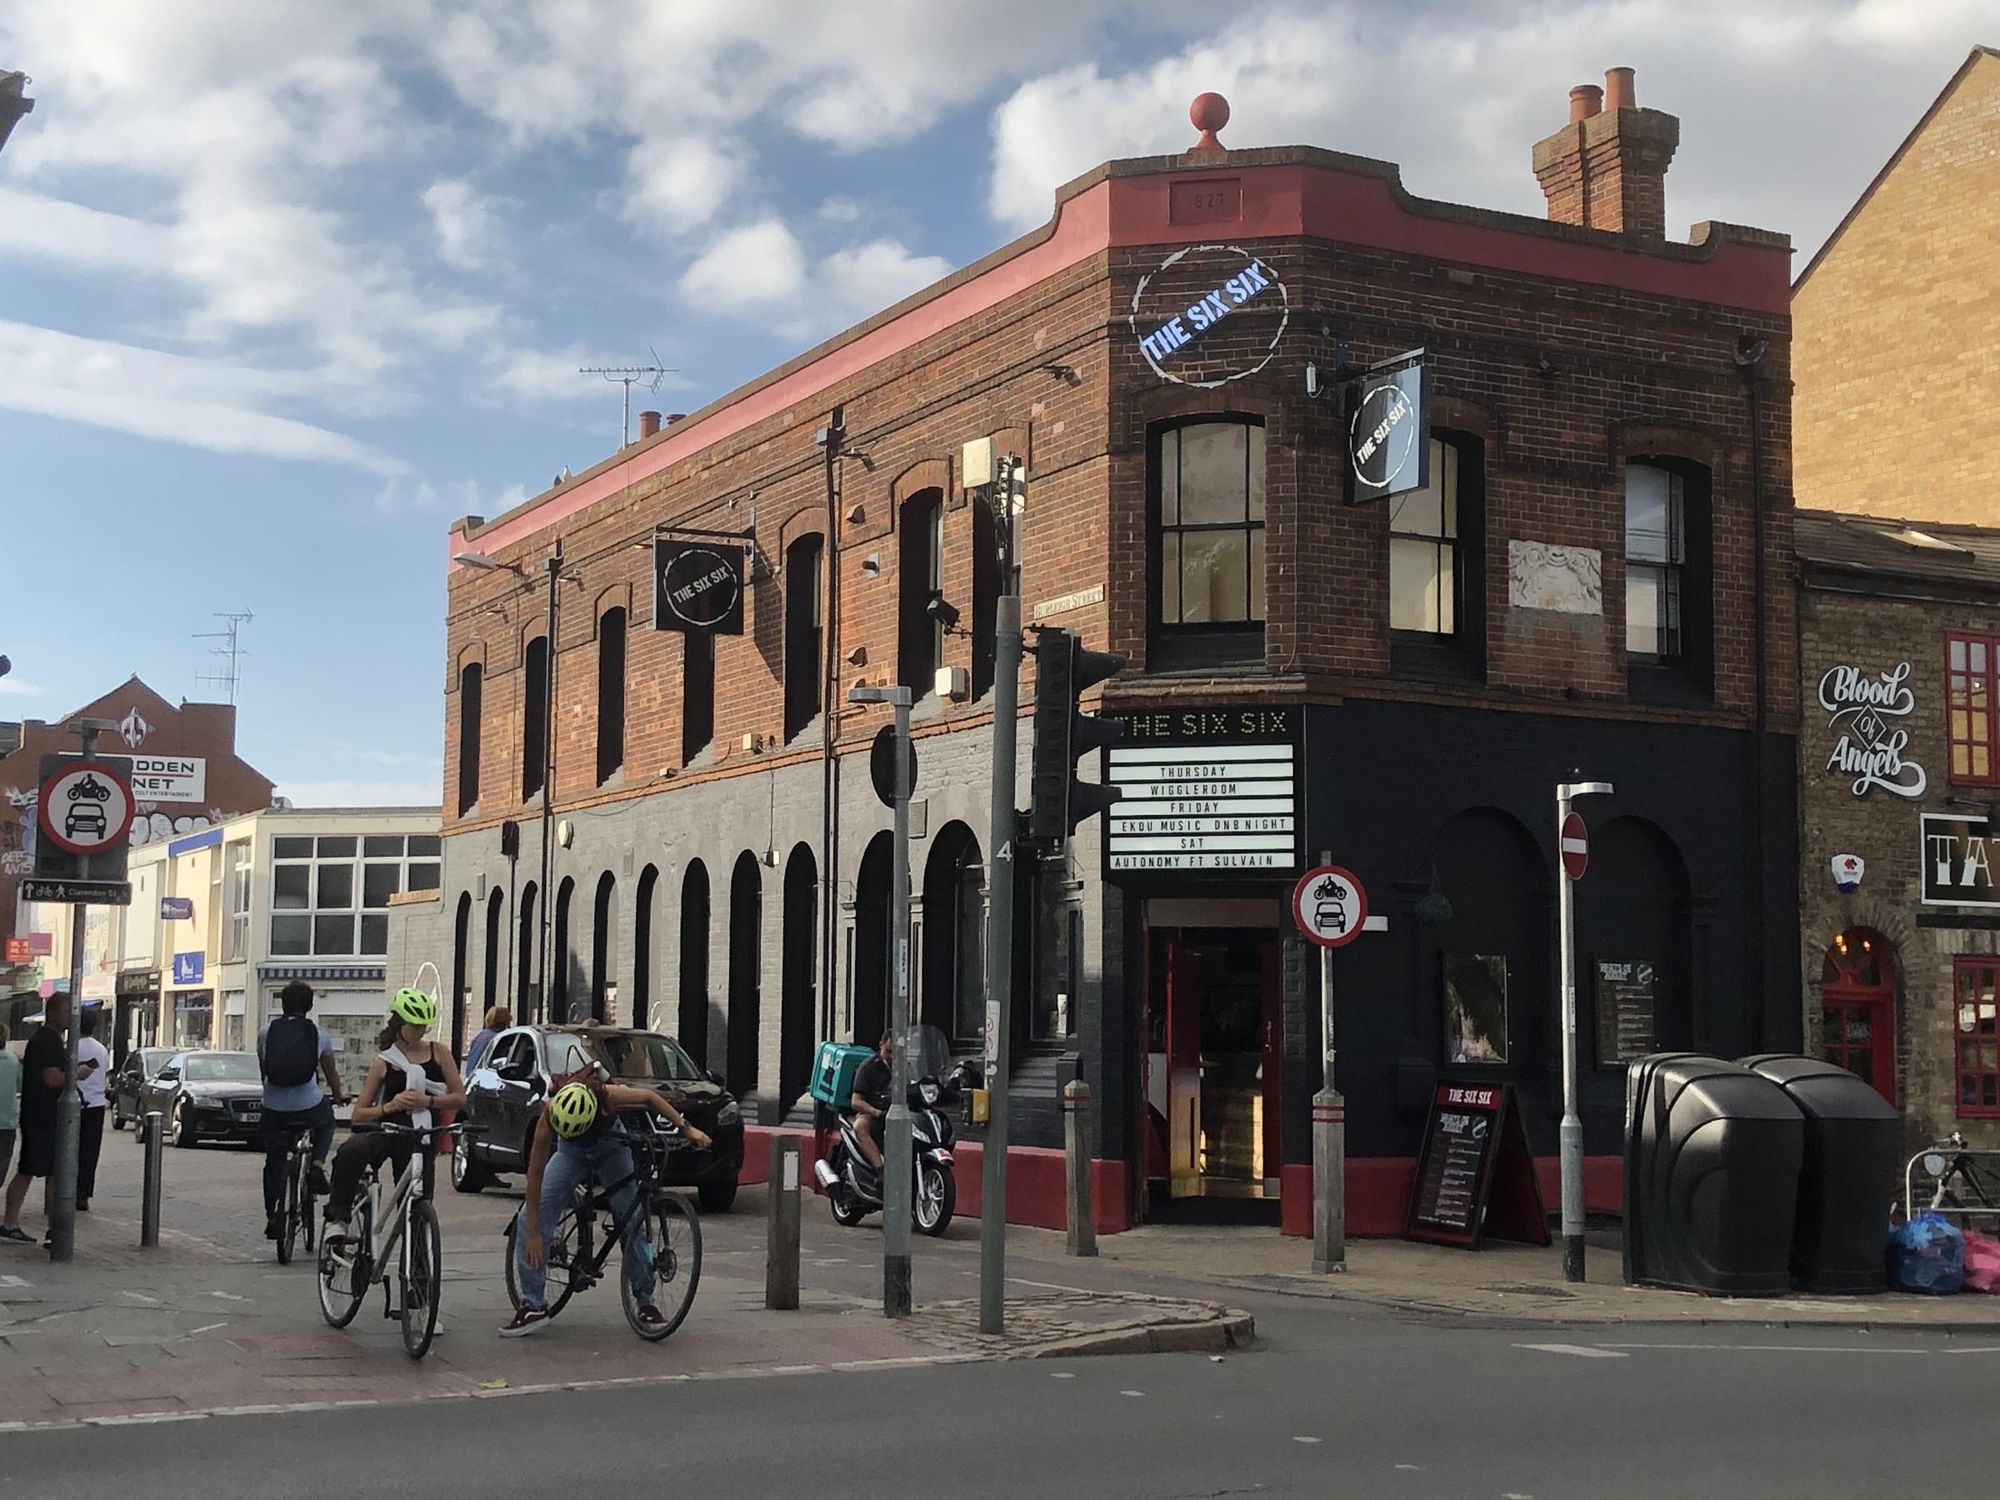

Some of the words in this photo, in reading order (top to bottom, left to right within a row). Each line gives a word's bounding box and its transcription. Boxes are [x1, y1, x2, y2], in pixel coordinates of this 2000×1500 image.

[1142, 316, 1192, 361] THE
[1187, 289, 1231, 331] SIX
[1225, 262, 1270, 304] SIX
[1356, 436, 1377, 465] THE
[1373, 418, 1391, 444] SIX
[1389, 399, 1406, 426] SIX
[672, 584, 696, 604] THE
[692, 574, 713, 593] SIX
[710, 565, 730, 584] SIX
[1819, 662, 1914, 715] Blood
[1182, 713, 1228, 736] SIX
[1240, 711, 1286, 734] SIX
[1860, 716, 1877, 740] Of
[136, 760, 194, 773] DDEN
[1160, 766, 1226, 778] THURSDAY
[1826, 729, 1927, 797] Angels
[132, 777, 174, 789] NET
[1150, 783, 1236, 796] WIGGLEROOM
[1170, 802, 1219, 813] FRIDAY
[1122, 821, 1153, 832] EKOU
[1161, 820, 1201, 831] MUSIC
[1245, 818, 1286, 830] NIGHT
[996, 840, 1013, 862] 4
[1181, 838, 1204, 849] SAT
[1114, 856, 1180, 868] AUTONOMY
[1189, 856, 1203, 867] FT
[1214, 855, 1273, 867] SULVAIN
[1925, 834, 2000, 888] TA
[1449, 1089, 1464, 1102] THE
[1464, 1090, 1478, 1103] SIX
[1478, 1091, 1492, 1104] SIX
